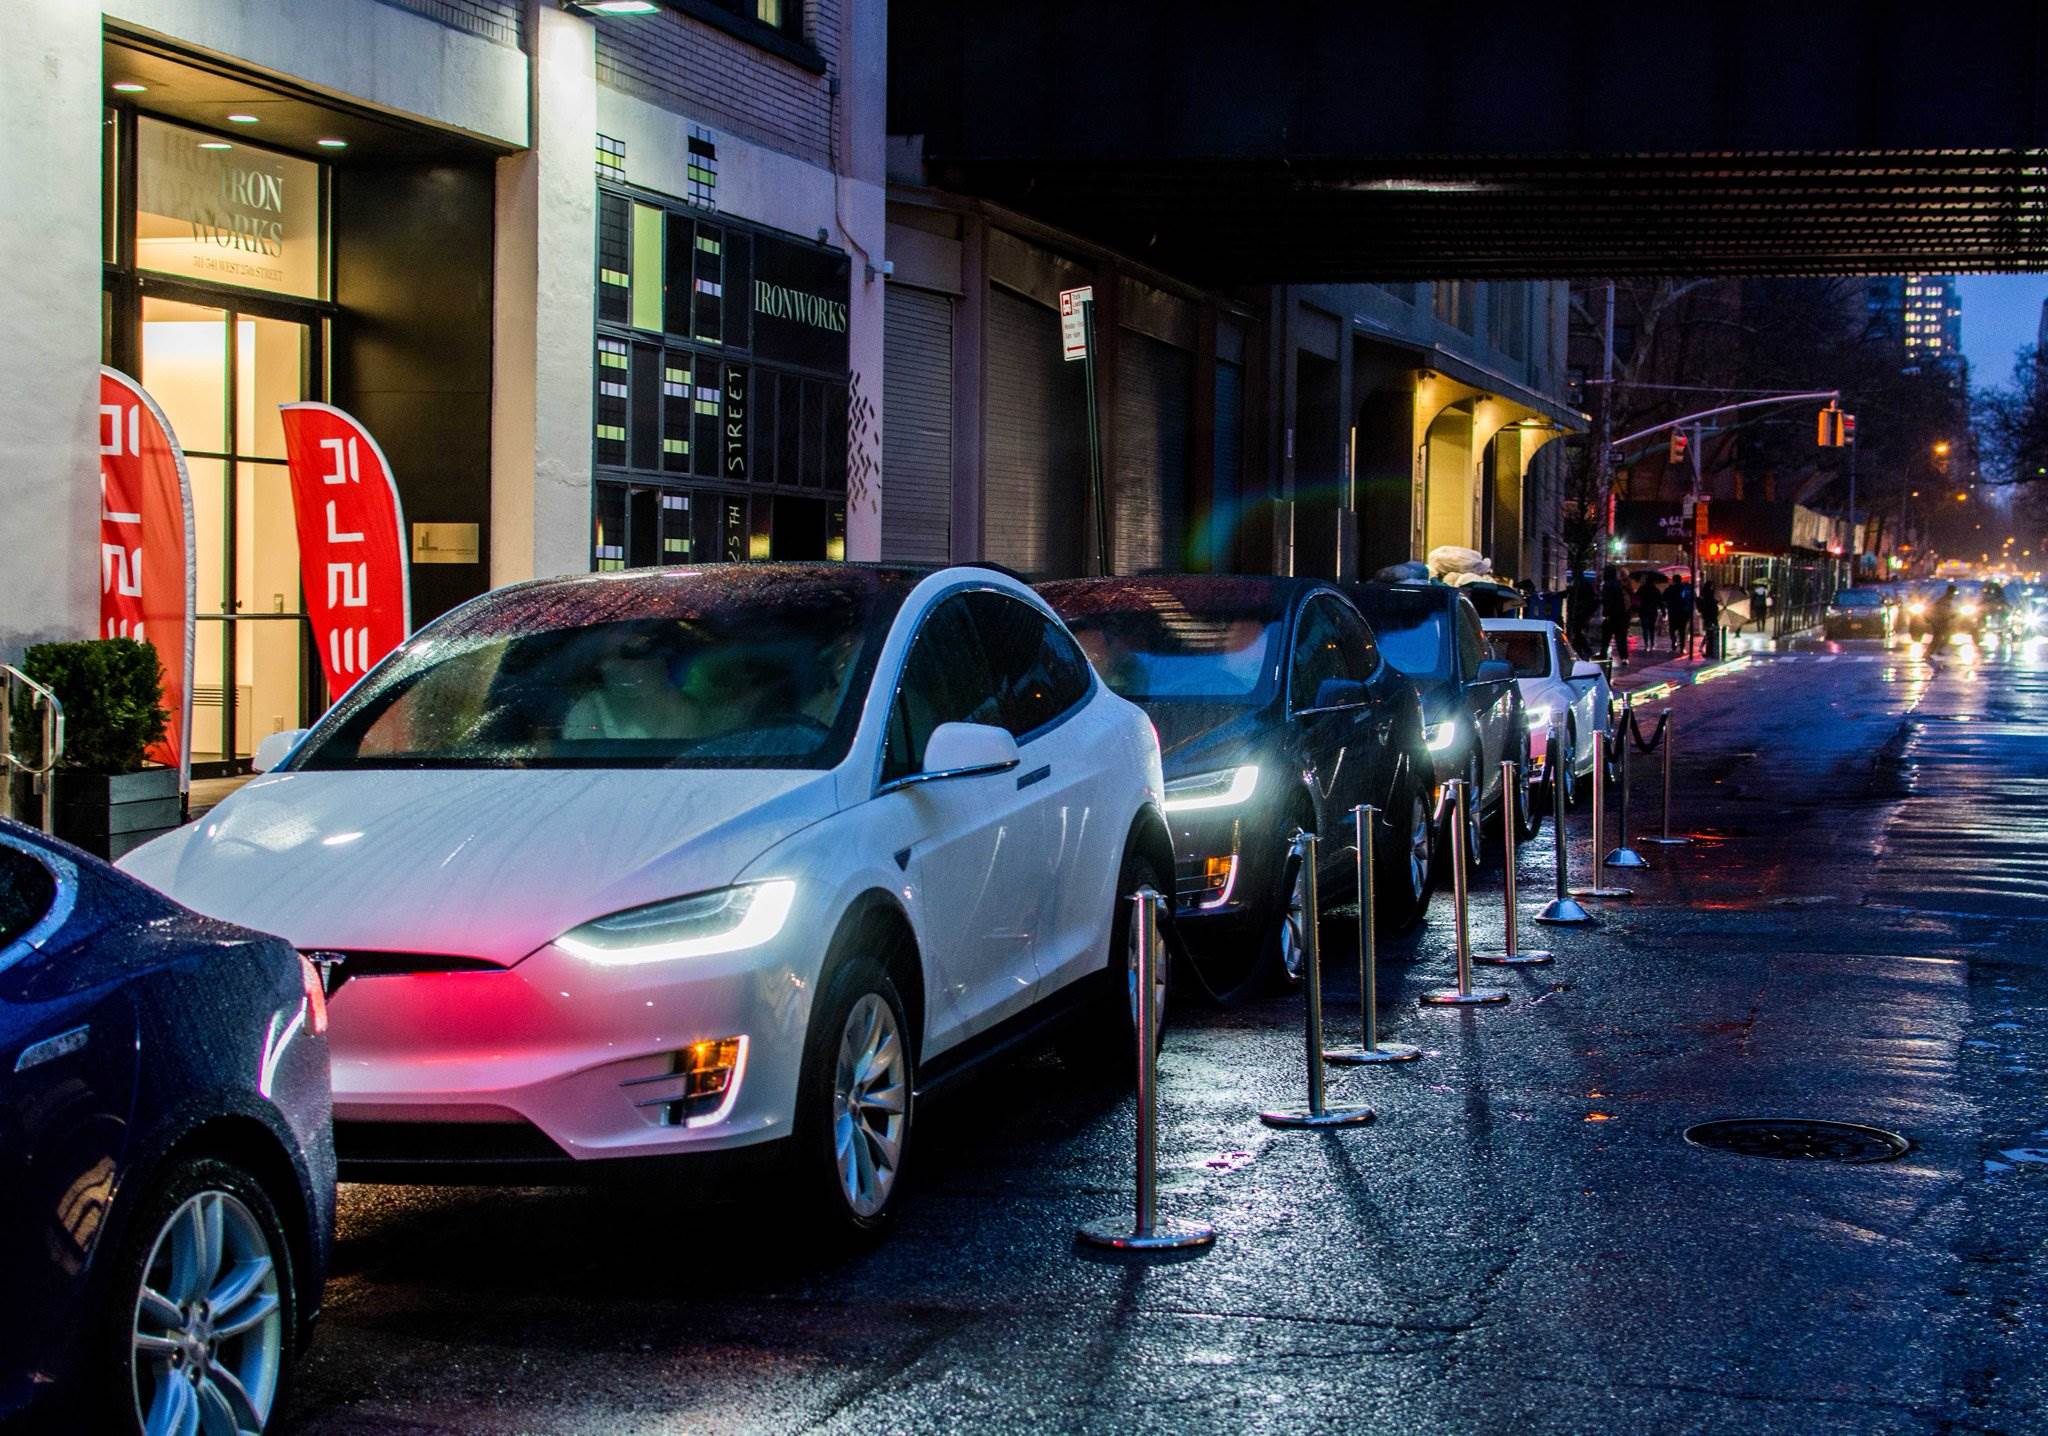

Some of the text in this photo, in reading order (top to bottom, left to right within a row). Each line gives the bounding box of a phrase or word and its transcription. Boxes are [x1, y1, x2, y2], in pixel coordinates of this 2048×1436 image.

[220, 166, 283, 213] IRON
[190, 206, 283, 258] WORKS
[255, 267, 283, 281] STREET
[754, 279, 846, 333] IRONWORKS
[728, 369, 744, 472] STREET
